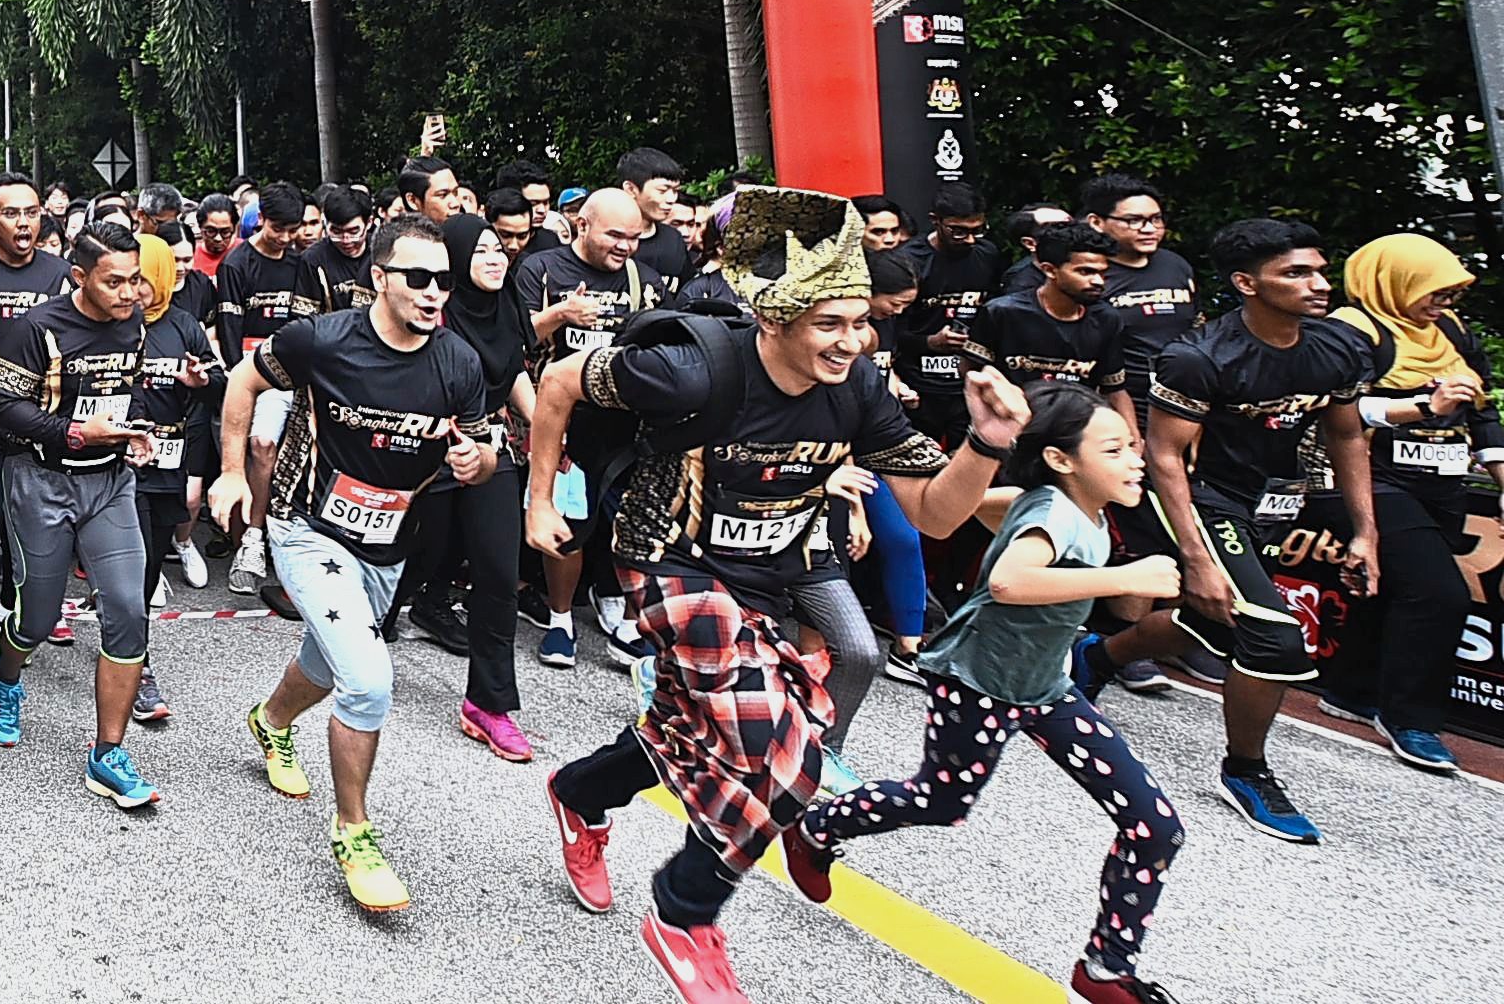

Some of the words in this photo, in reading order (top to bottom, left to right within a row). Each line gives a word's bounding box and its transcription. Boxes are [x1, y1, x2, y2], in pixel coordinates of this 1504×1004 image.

[1154, 288, 1192, 304] RUN
[151, 376, 175, 385] msu
[157, 441, 180, 456] 191
[390, 435, 422, 448] msu
[779, 463, 813, 474] msu
[330, 499, 395, 529] S0151
